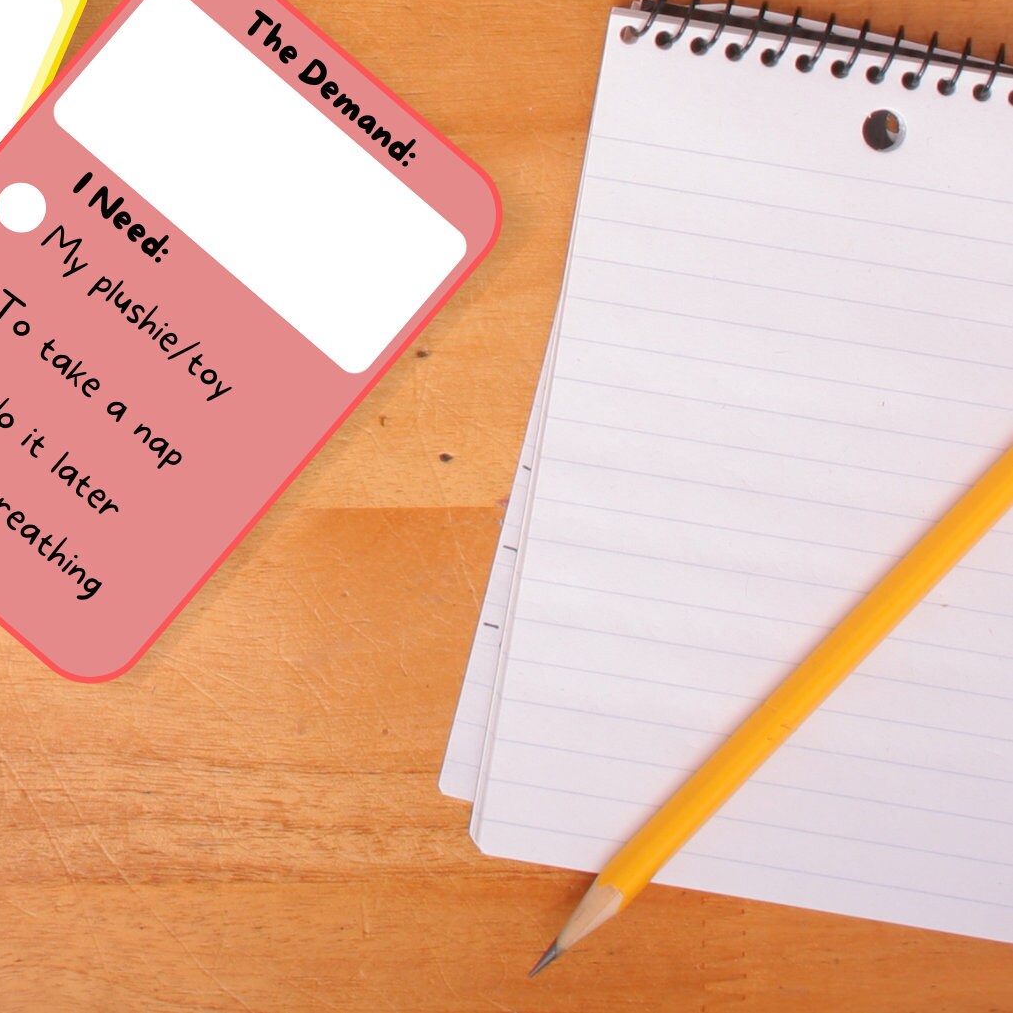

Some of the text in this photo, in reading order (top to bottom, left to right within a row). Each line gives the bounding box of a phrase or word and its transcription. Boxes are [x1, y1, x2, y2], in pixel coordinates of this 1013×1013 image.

[246, 9, 416, 167] The Demand:
[71, 171, 170, 263] I Need:
[40, 225, 232, 402] My plushie/toy
[40, 338, 100, 399] take
[106, 400, 127, 423] a
[133, 423, 183, 470] nap
[19, 429, 46, 459] it
[49, 451, 120, 516] later
